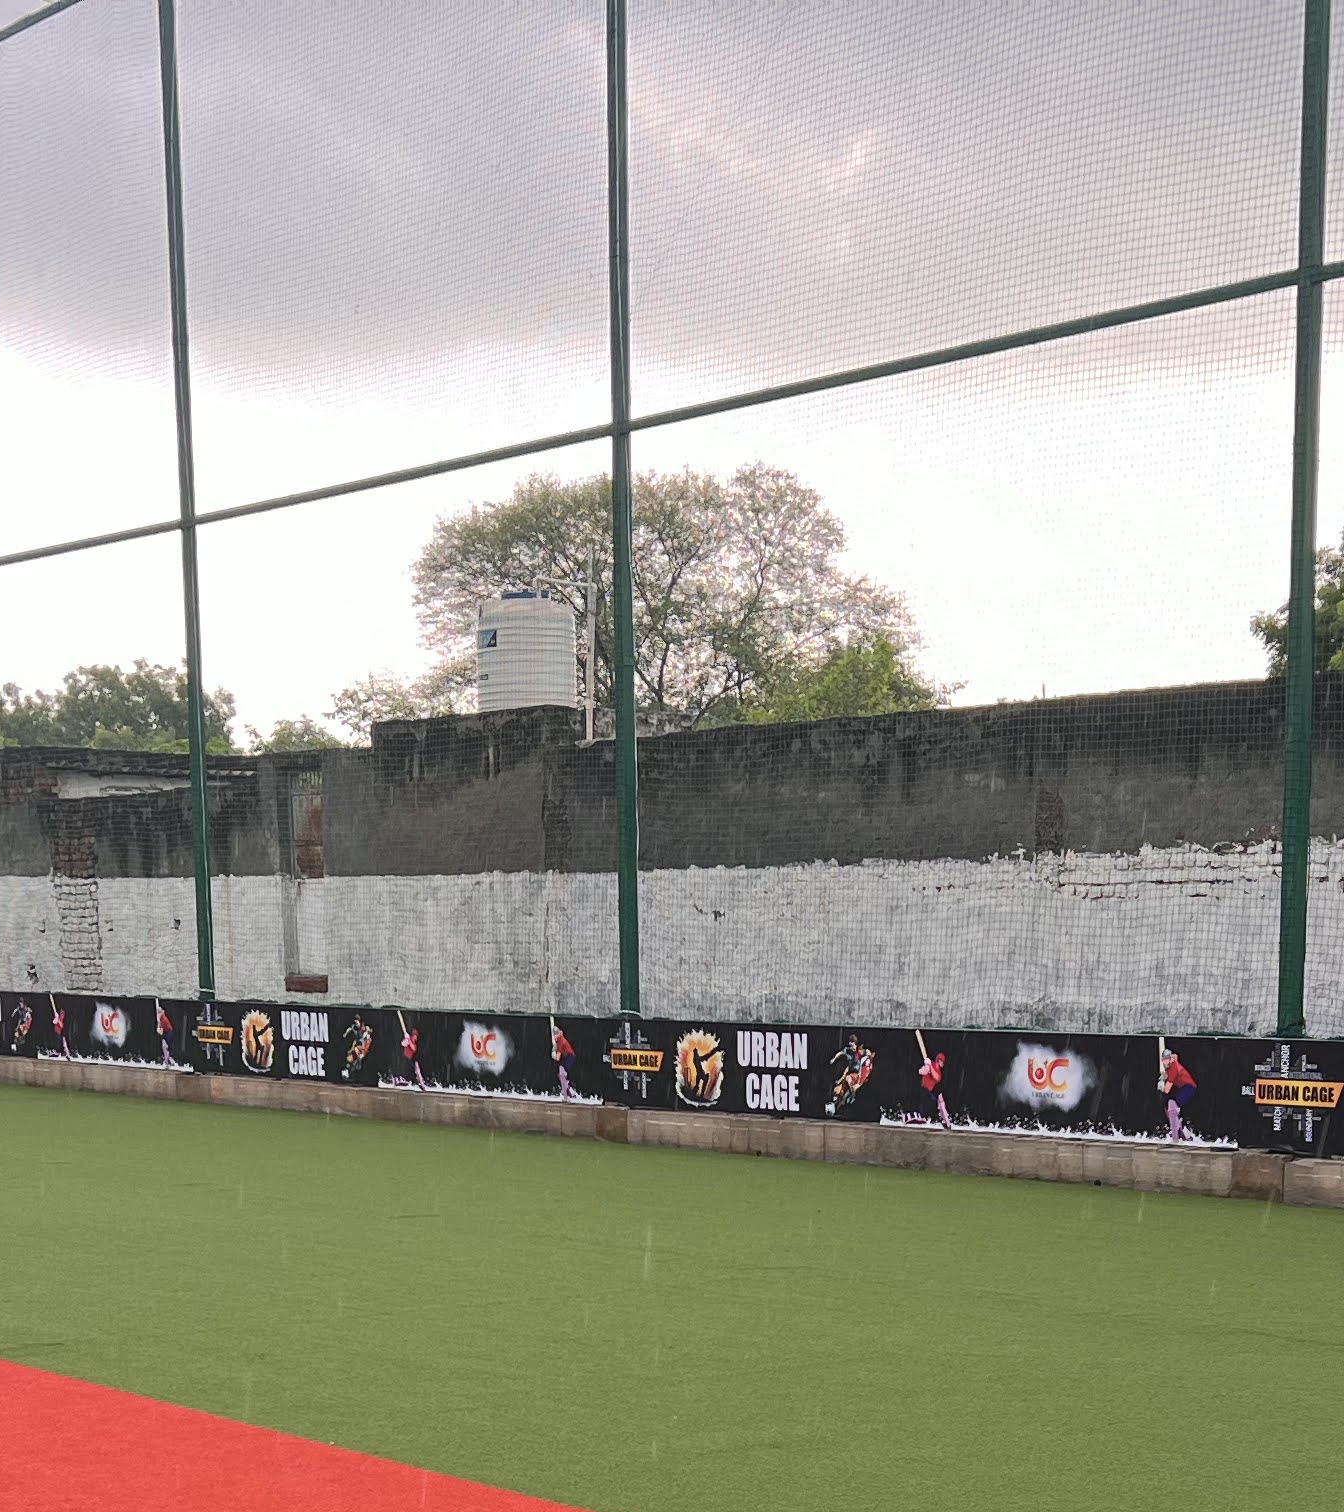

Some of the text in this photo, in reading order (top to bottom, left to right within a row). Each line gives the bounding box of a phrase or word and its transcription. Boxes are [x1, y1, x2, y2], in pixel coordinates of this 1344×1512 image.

[281, 1011, 329, 1042] URBAN
[288, 1045, 325, 1077] CAGE
[612, 1053, 637, 1066] URBAN
[639, 1055, 659, 1067] CAGE
[736, 1030, 808, 1070] URBAN
[745, 1073, 800, 1112] CAGE
[1258, 1084, 1335, 1103] URBAN CAGE
